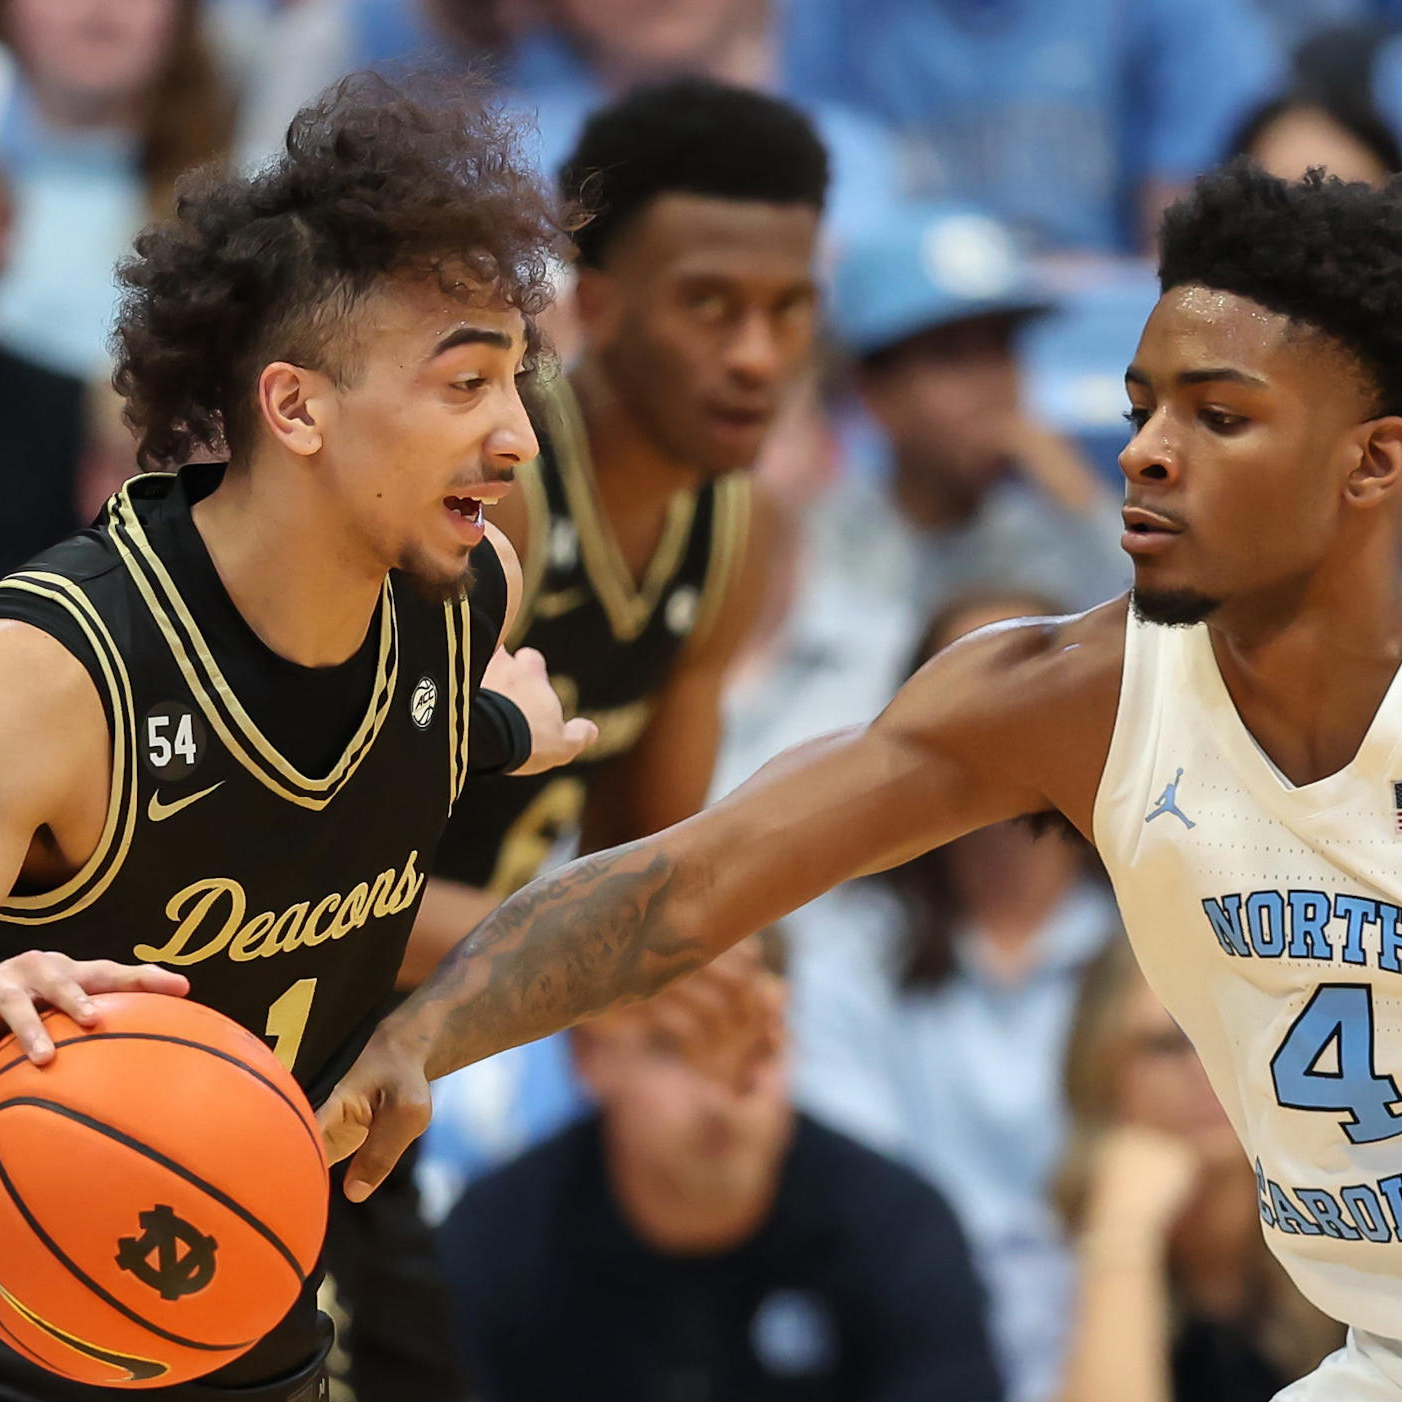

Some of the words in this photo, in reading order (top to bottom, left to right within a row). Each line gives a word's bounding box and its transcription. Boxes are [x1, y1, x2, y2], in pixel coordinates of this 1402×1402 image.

[147, 713, 197, 767] 54
[133, 850, 424, 966] Deacons
[265, 978, 318, 1073] 1
